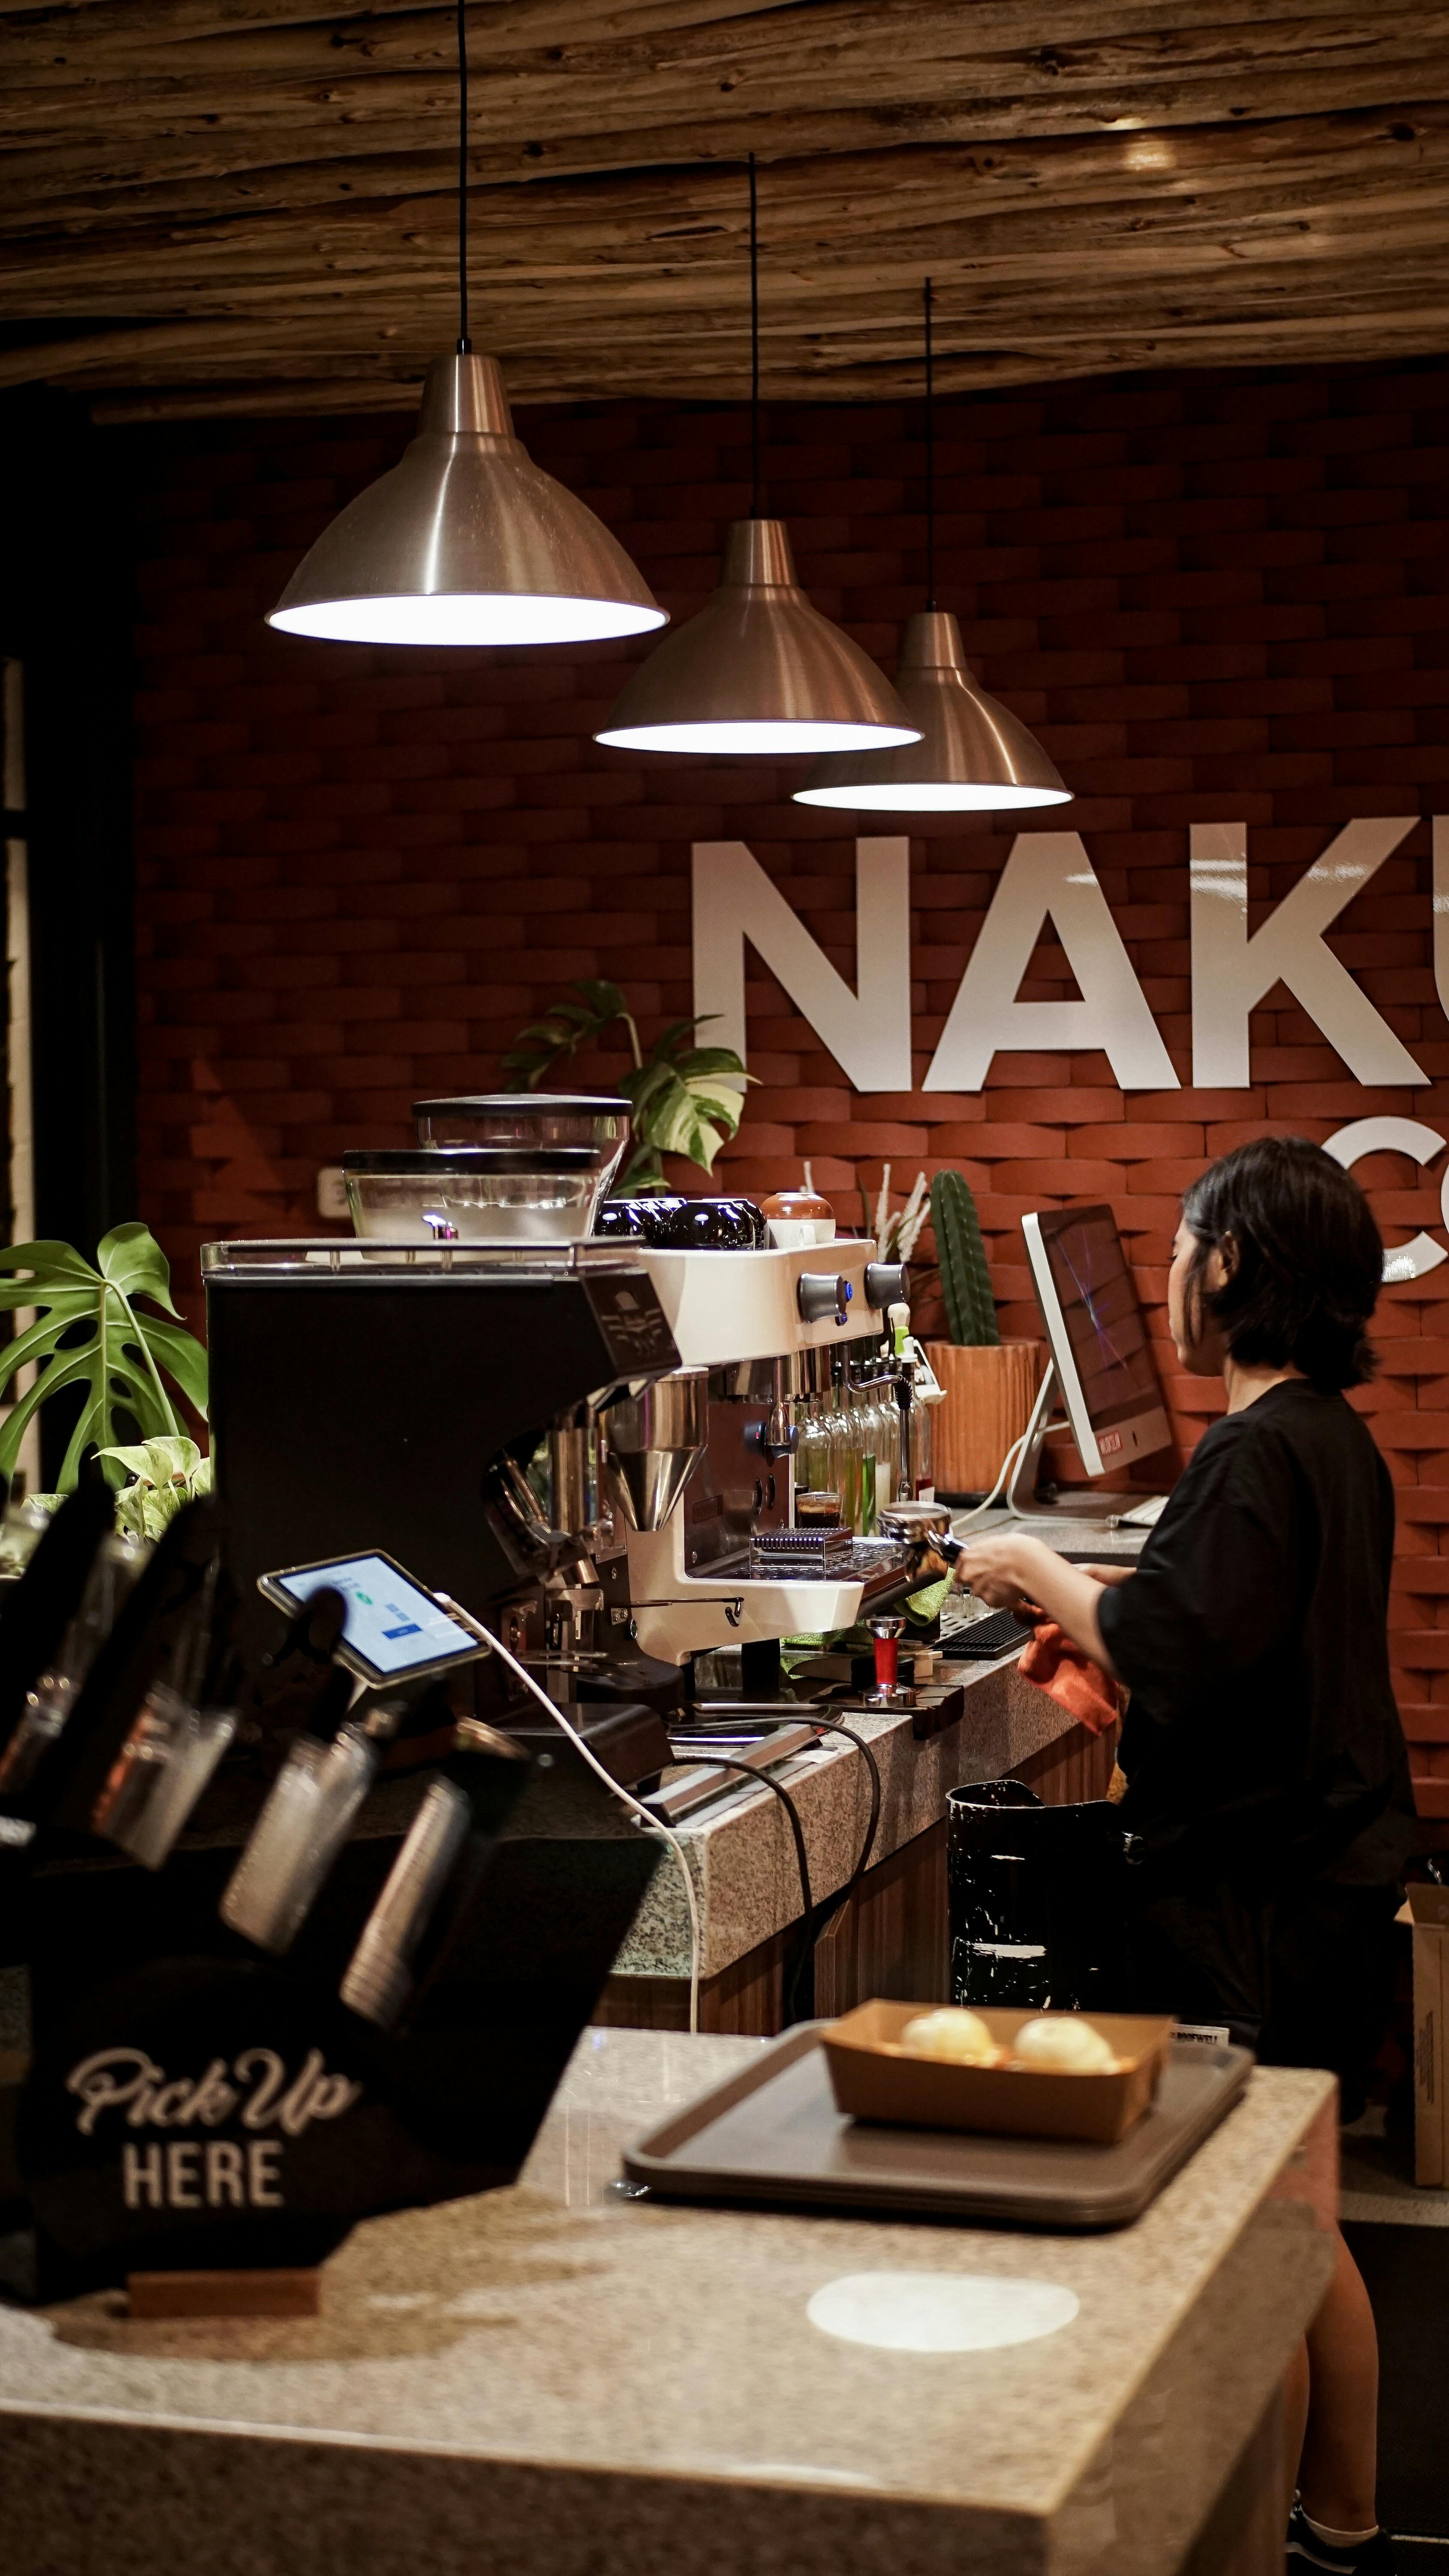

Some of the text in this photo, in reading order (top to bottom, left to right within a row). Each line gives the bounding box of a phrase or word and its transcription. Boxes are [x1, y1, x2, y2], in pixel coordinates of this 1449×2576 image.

[691, 814, 1449, 1093] NAK
[1321, 1115, 1449, 1283] C
[65, 2046, 364, 2137] Pick Up
[122, 2140, 285, 2208] HERE
